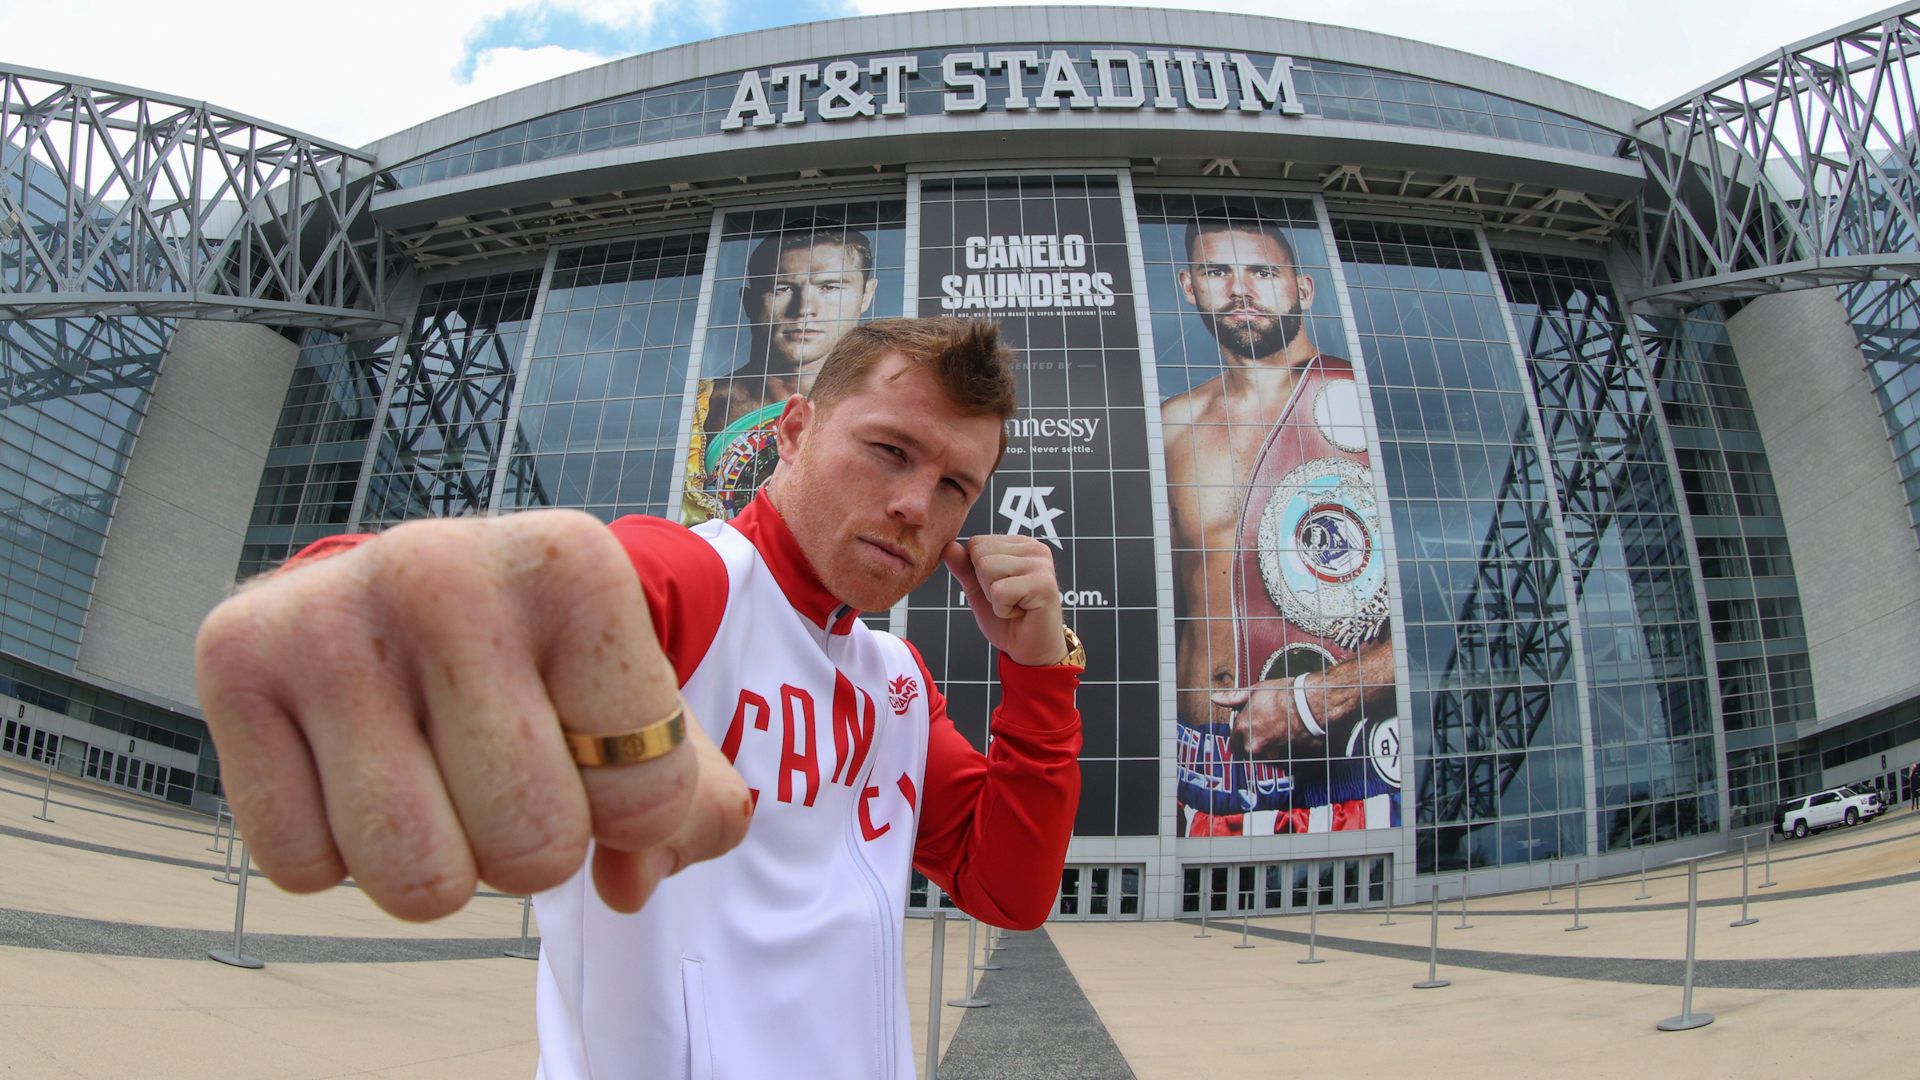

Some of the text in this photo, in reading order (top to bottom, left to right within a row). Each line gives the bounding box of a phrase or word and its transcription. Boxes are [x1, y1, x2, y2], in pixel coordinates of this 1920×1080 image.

[720, 49, 1304, 131] AT&T STADIUM
[965, 234, 1087, 270] CANELO
[941, 271, 1115, 309] SAUNDERS
[1005, 417, 1100, 442] nnessy
[1006, 445, 1094, 455] top. Never settle.
